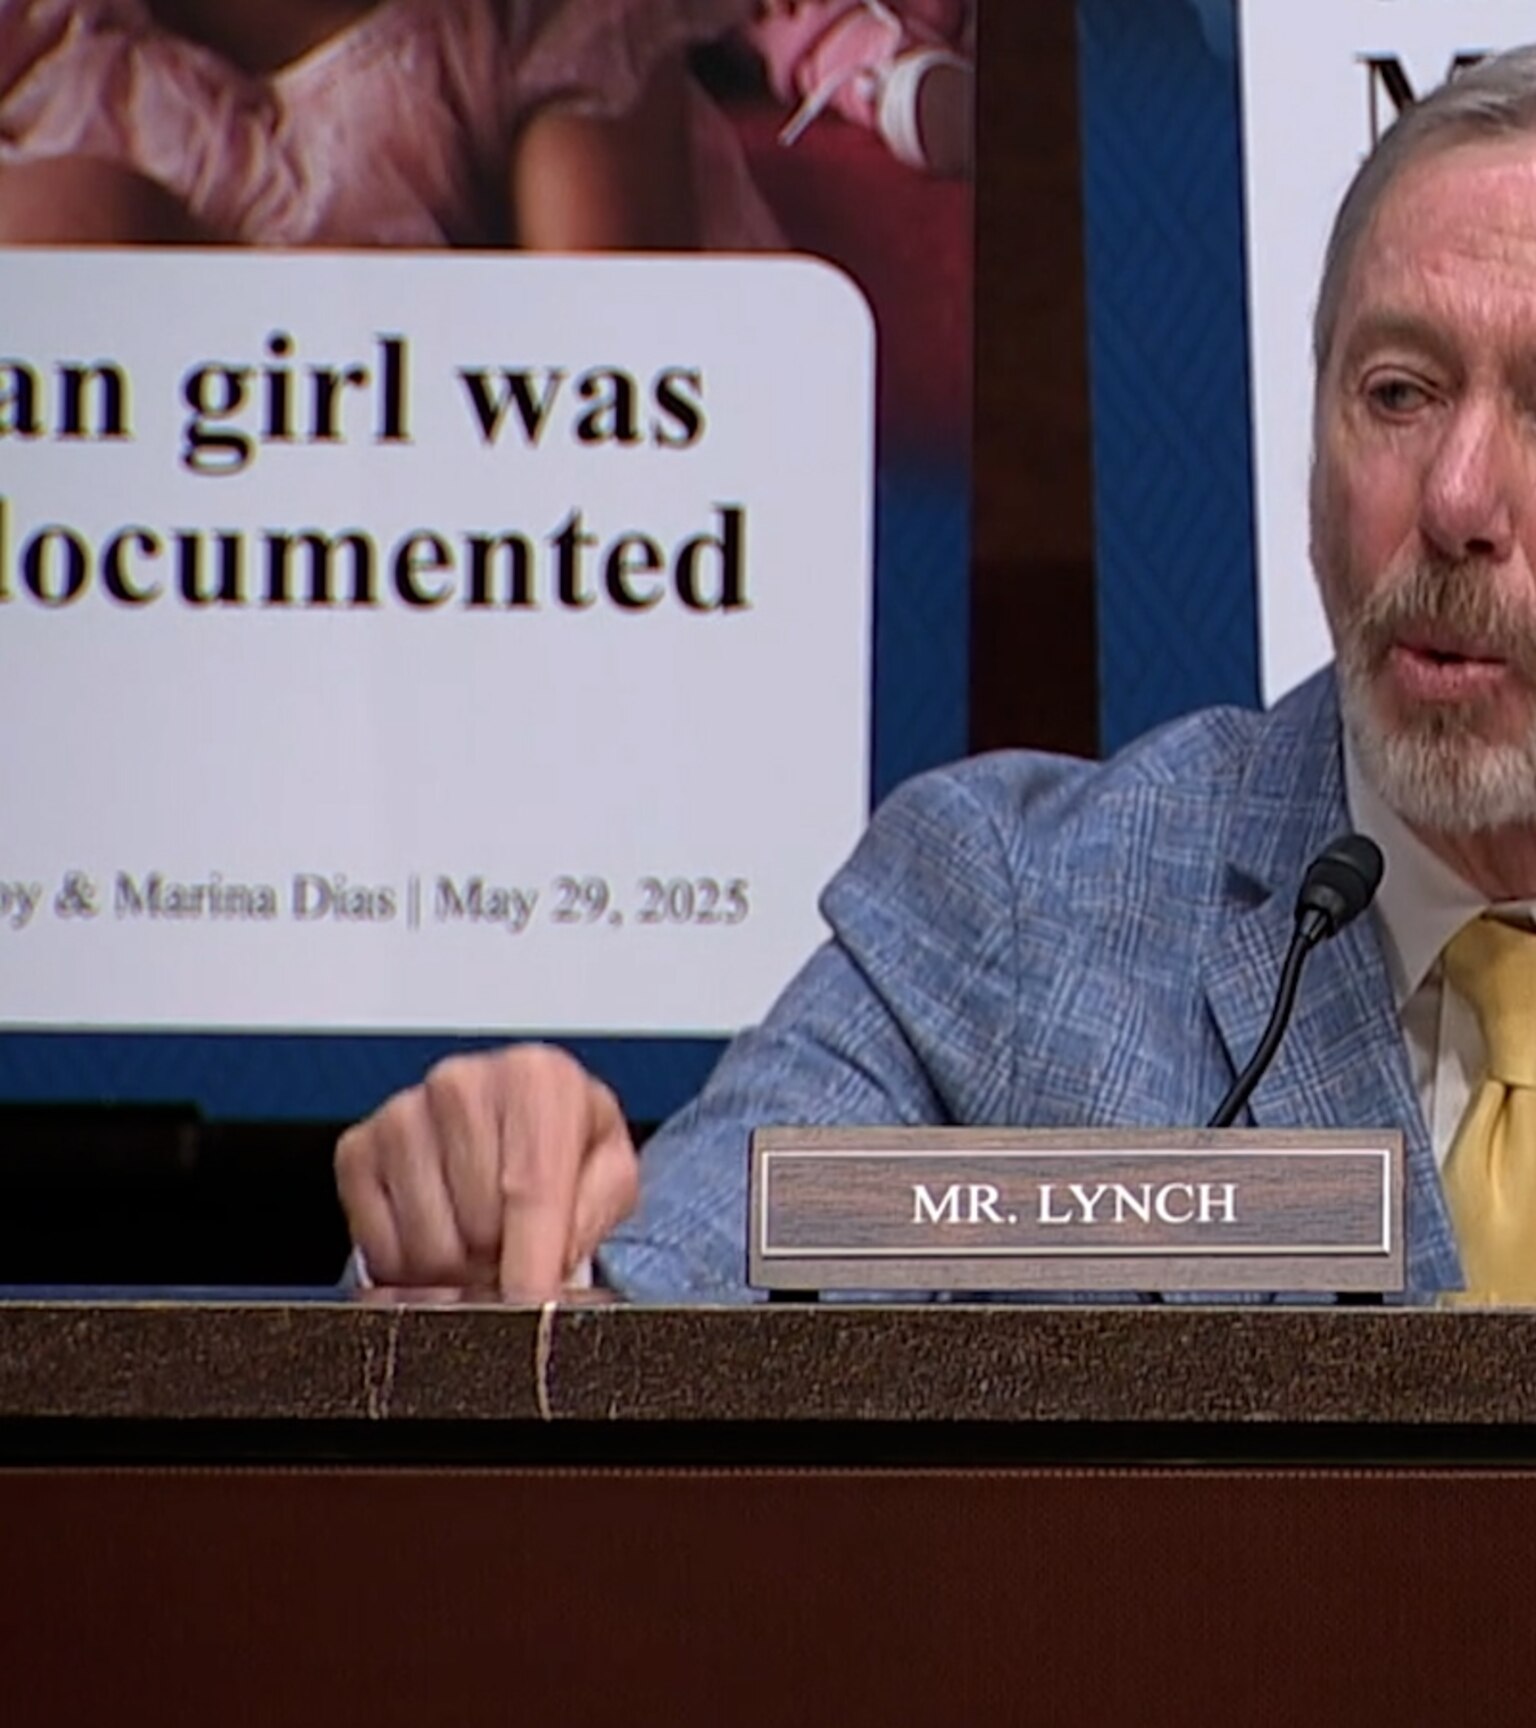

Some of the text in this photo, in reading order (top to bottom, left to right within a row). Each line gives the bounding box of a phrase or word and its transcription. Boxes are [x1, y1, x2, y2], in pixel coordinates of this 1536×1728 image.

[0, 331, 706, 476] an girl was
[0, 495, 747, 613] ocumented
[53, 870, 98, 919] &
[114, 870, 277, 920] Marina
[291, 873, 397, 921] Dias
[434, 875, 539, 933] May
[552, 875, 624, 927] 29,
[638, 877, 749, 925] 2025
[912, 1182, 1238, 1224] MR. LYNCH
